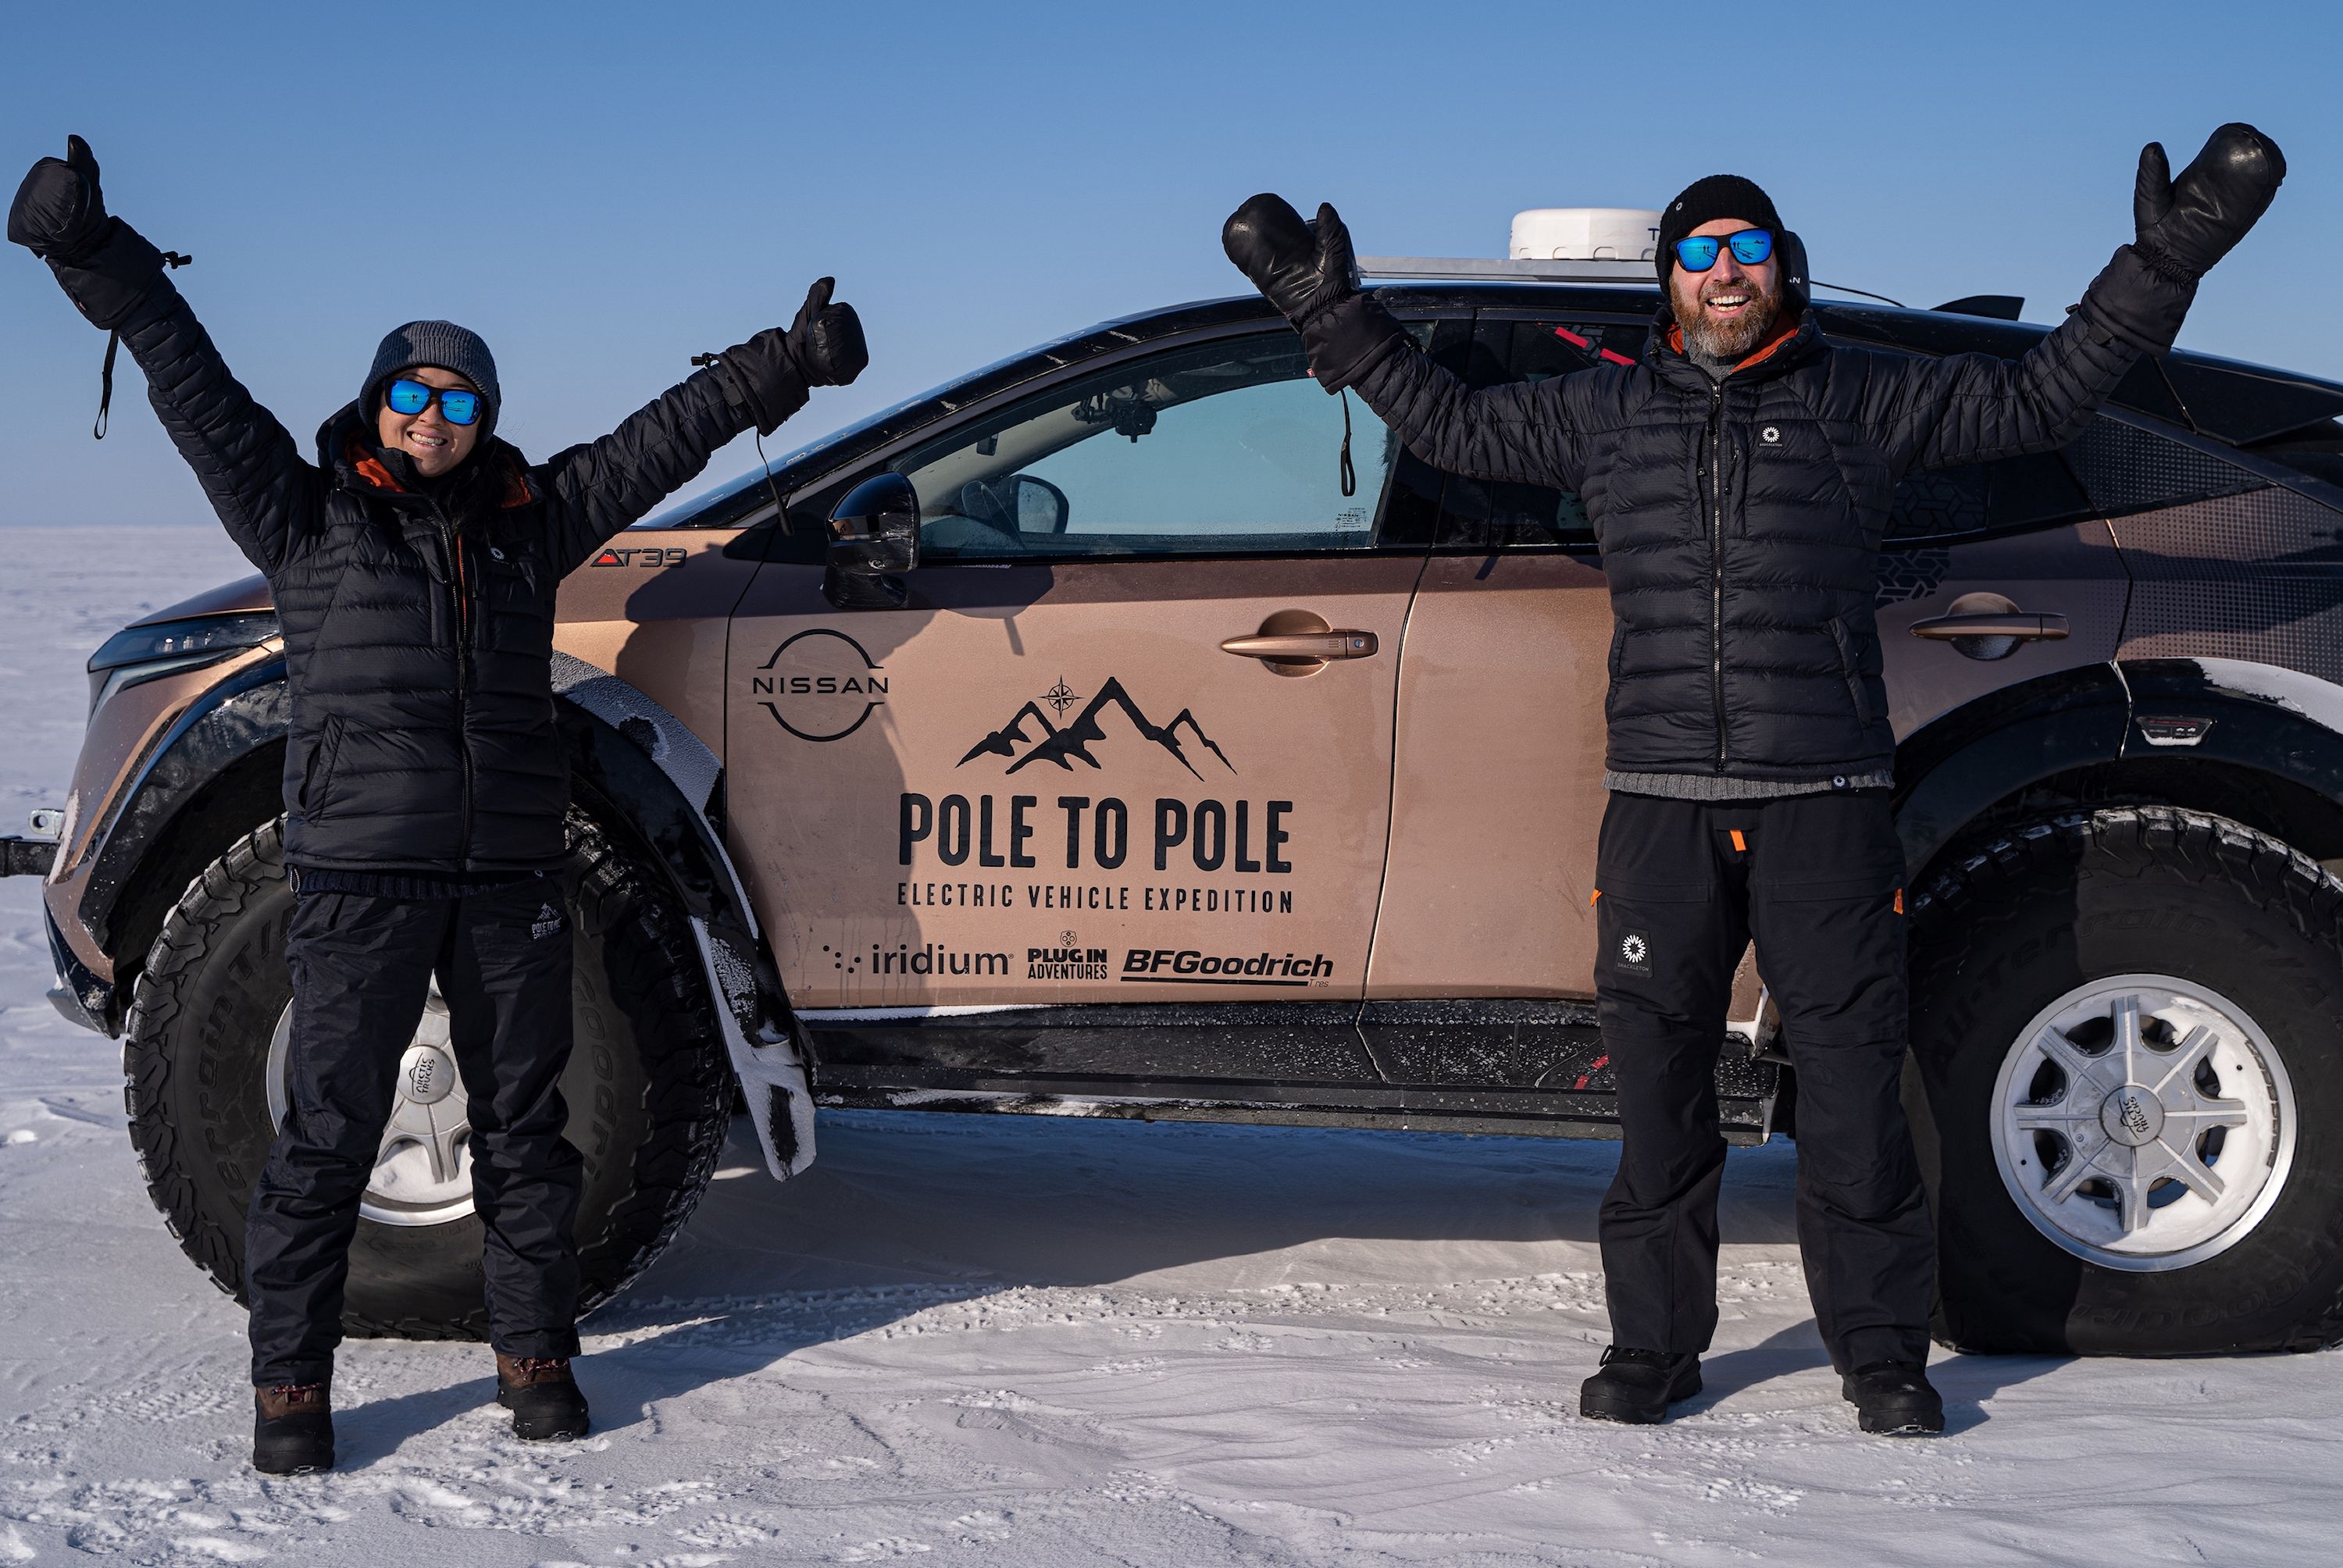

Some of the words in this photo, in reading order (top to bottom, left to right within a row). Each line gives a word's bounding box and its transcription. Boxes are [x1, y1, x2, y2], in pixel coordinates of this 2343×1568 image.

[753, 677, 889, 694] NISSAN
[899, 793, 1037, 868] POLE
[1057, 796, 1128, 869] TO
[1154, 798, 1293, 873] POLE
[897, 882, 1013, 907] ELECTRIC
[1027, 885, 1129, 910] VEHICLE
[1144, 887, 1293, 914] EXPEDITION
[1027, 948, 1083, 963] PLUG
[1086, 949, 1107, 963] IN
[1027, 964, 1107, 980] ADVENTURES
[1122, 949, 1334, 978] BFGoodrich
[415, 1057, 429, 1093] ARCTIC
[422, 1058, 435, 1093] TRUCKS
[2122, 1099, 2144, 1133] ARCTIC
[2128, 1096, 2150, 1131] TRUCKS
